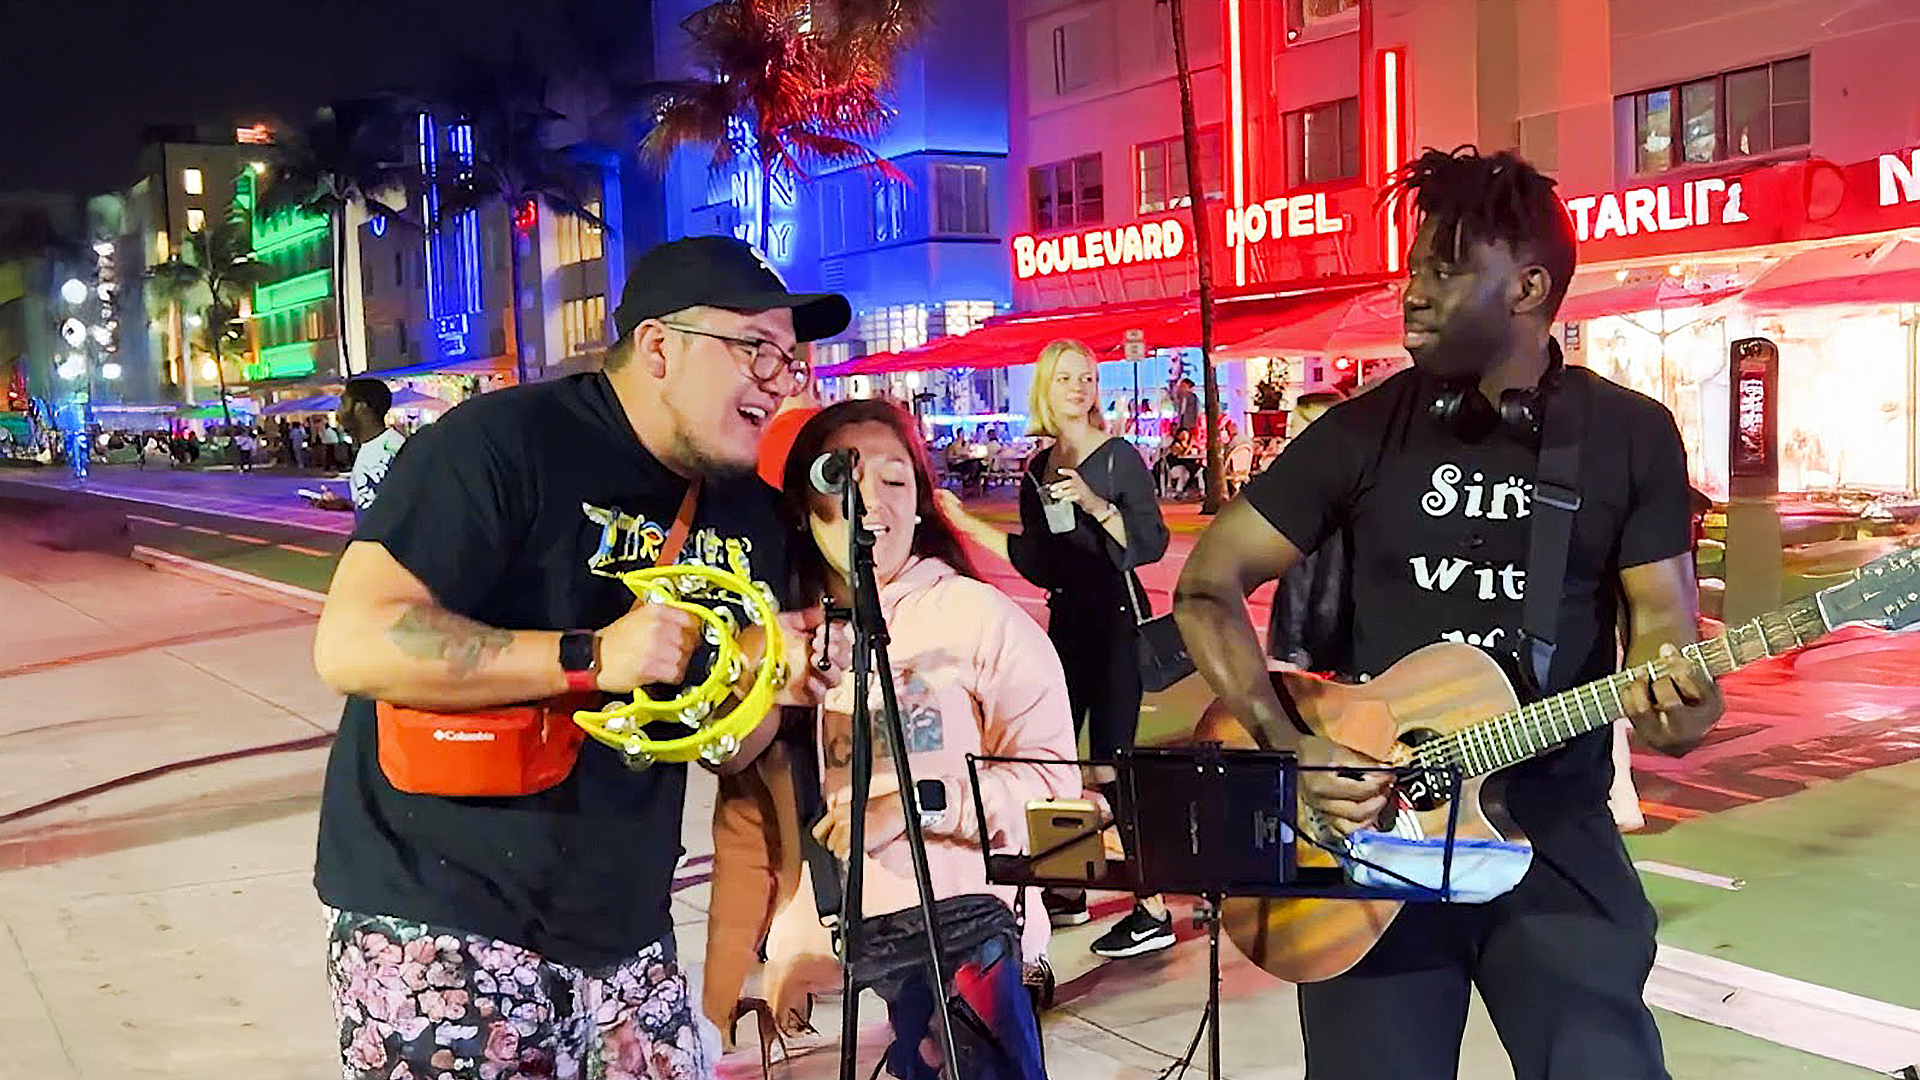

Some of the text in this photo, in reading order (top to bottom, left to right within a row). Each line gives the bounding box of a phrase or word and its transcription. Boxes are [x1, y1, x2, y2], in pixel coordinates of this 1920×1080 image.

[1014, 192, 1343, 278] BOULEVARD HOTEL
[1421, 463, 1533, 520] Sin
[1409, 556, 1527, 600] Wit
